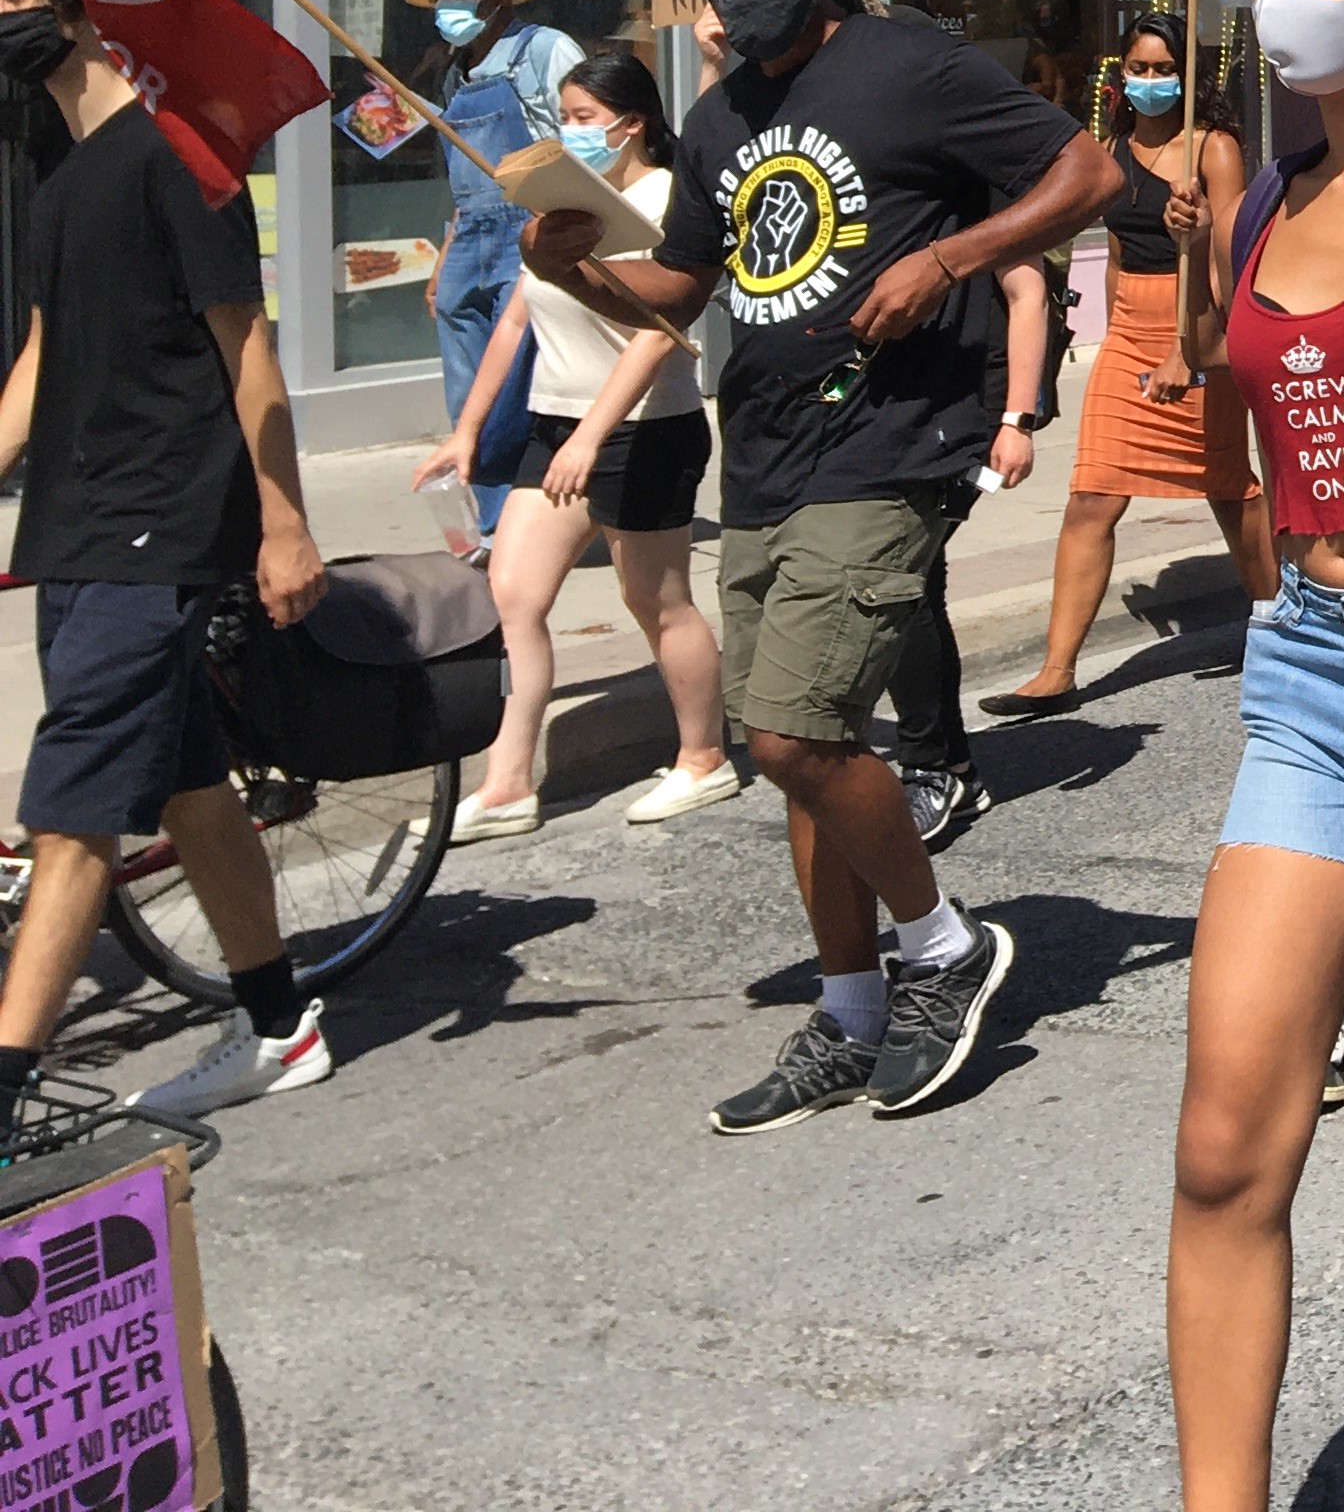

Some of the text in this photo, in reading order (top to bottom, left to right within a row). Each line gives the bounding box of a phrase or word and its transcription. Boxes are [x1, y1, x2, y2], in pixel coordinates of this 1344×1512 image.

[736, 124, 793, 172] CIVIL
[798, 126, 868, 215] RIGHTS
[746, 173, 763, 192] THE
[763, 160, 799, 174] THINGS
[730, 255, 849, 325] MOVEMENT
[1311, 431, 1336, 444] AND
[48, 1267, 157, 1338] BRUTALITY!
[71, 1310, 159, 1379] LIVES
[78, 1428, 105, 1471] NO
[110, 1394, 173, 1456] PEACE
